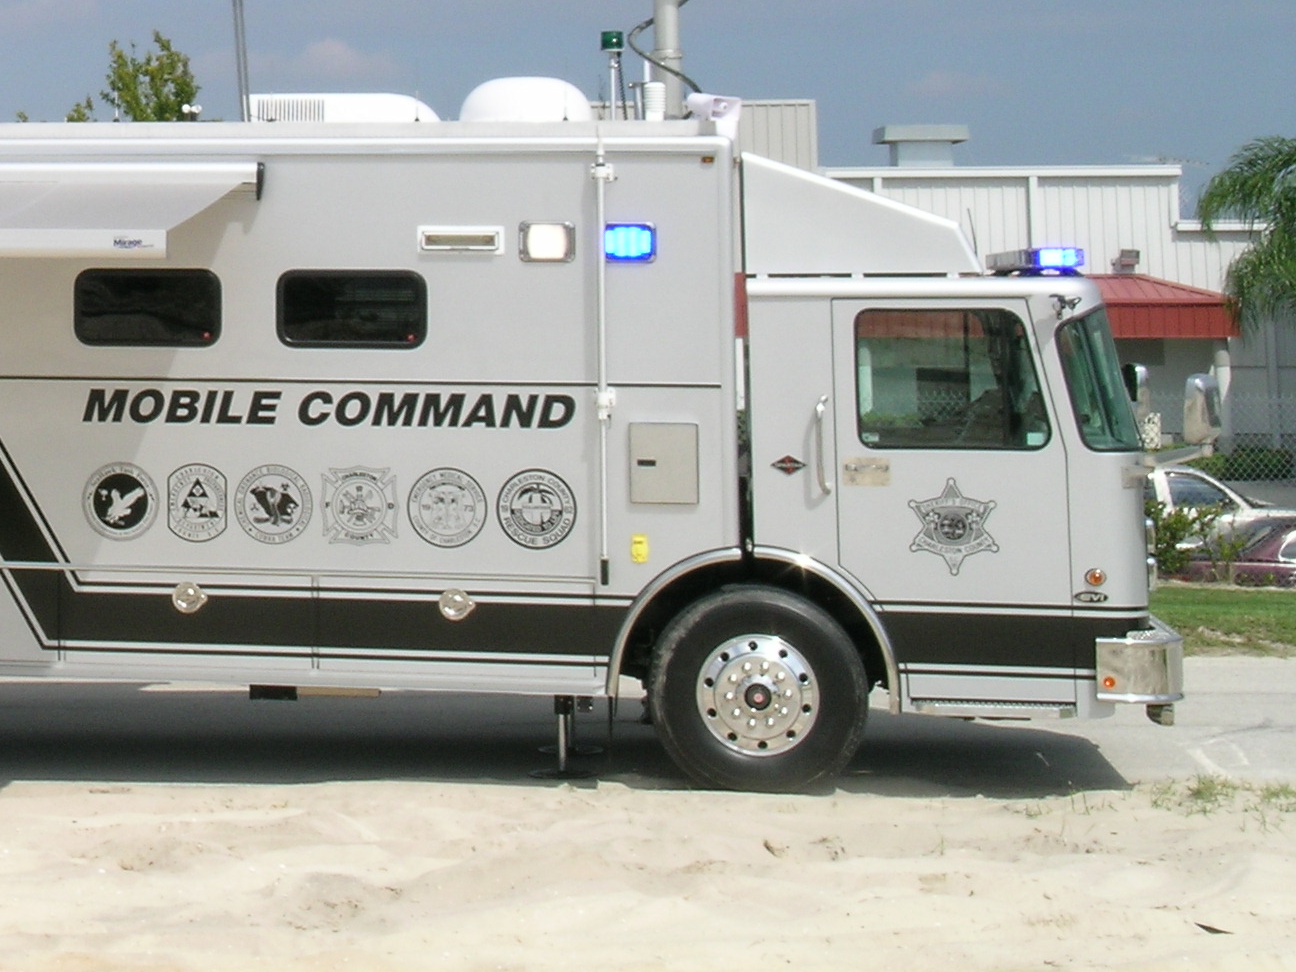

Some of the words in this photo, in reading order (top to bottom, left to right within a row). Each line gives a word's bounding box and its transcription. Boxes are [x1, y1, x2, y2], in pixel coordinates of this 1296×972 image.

[82, 388, 282, 425] MOBILE
[298, 391, 576, 429] COMMAND
[502, 474, 546, 504] CHARLESTON
[547, 478, 572, 505] COUNTY
[503, 517, 538, 545] RESCUE
[542, 518, 571, 545] SQUAD
[1080, 592, 1105, 602] EVI
